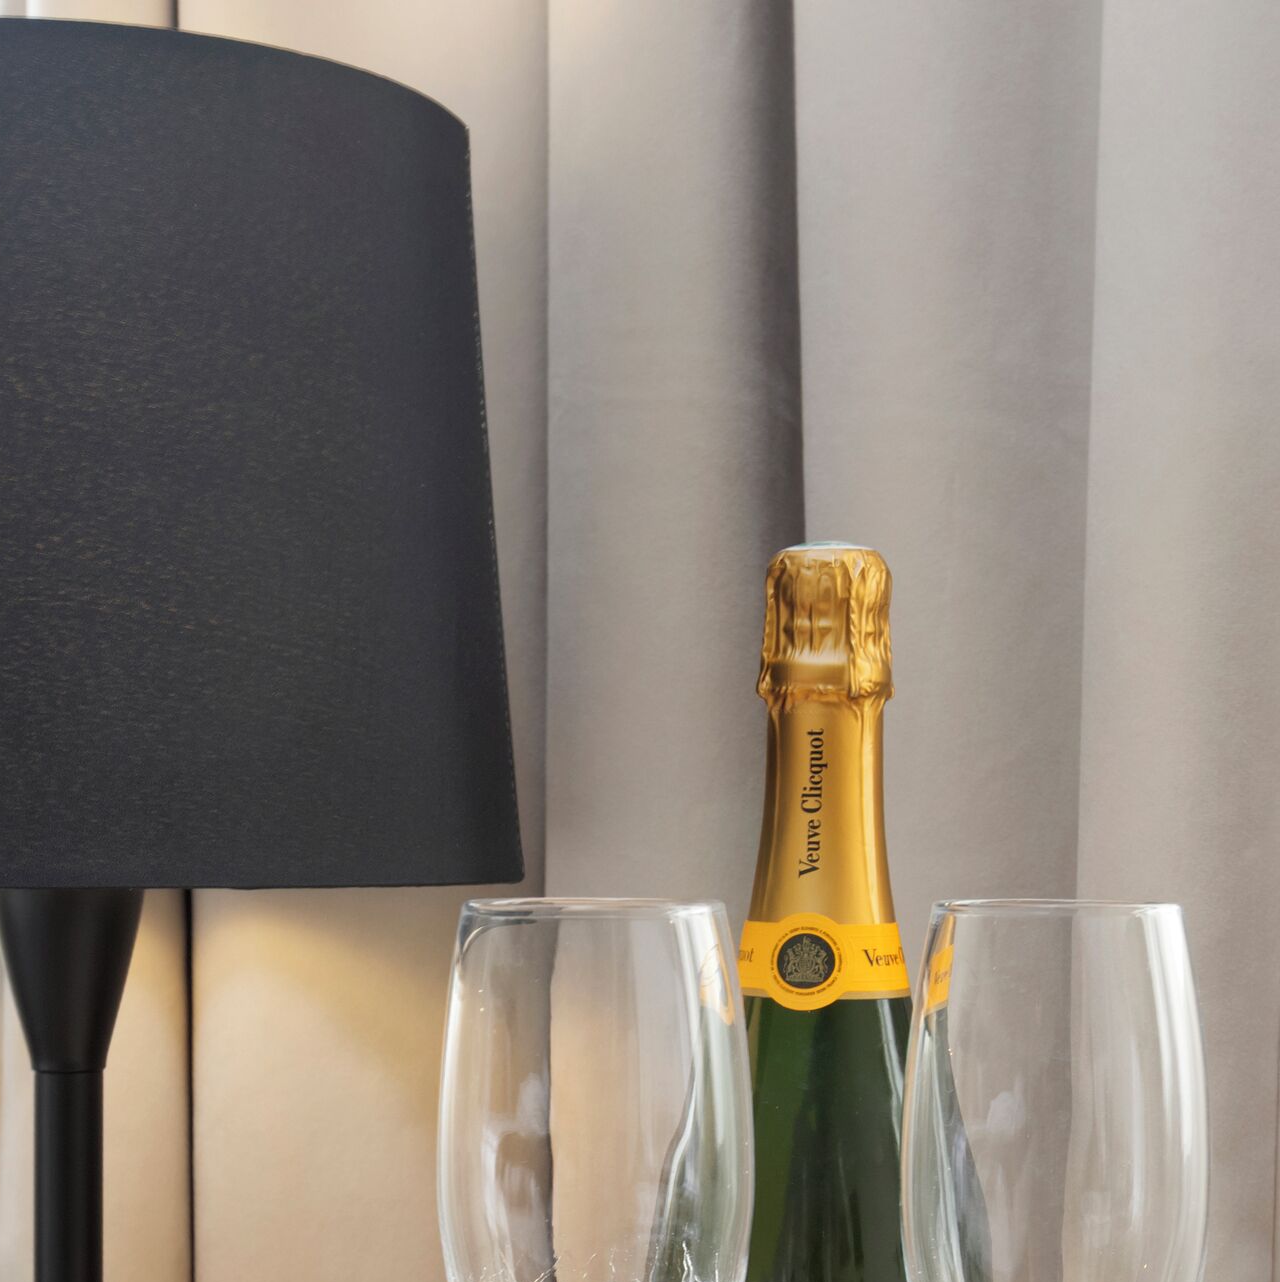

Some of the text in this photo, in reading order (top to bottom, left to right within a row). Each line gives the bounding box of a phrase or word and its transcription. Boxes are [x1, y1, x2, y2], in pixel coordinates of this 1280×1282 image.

[798, 727, 829, 879] Veuve Clicquot
[862, 947, 899, 968] Veuve
